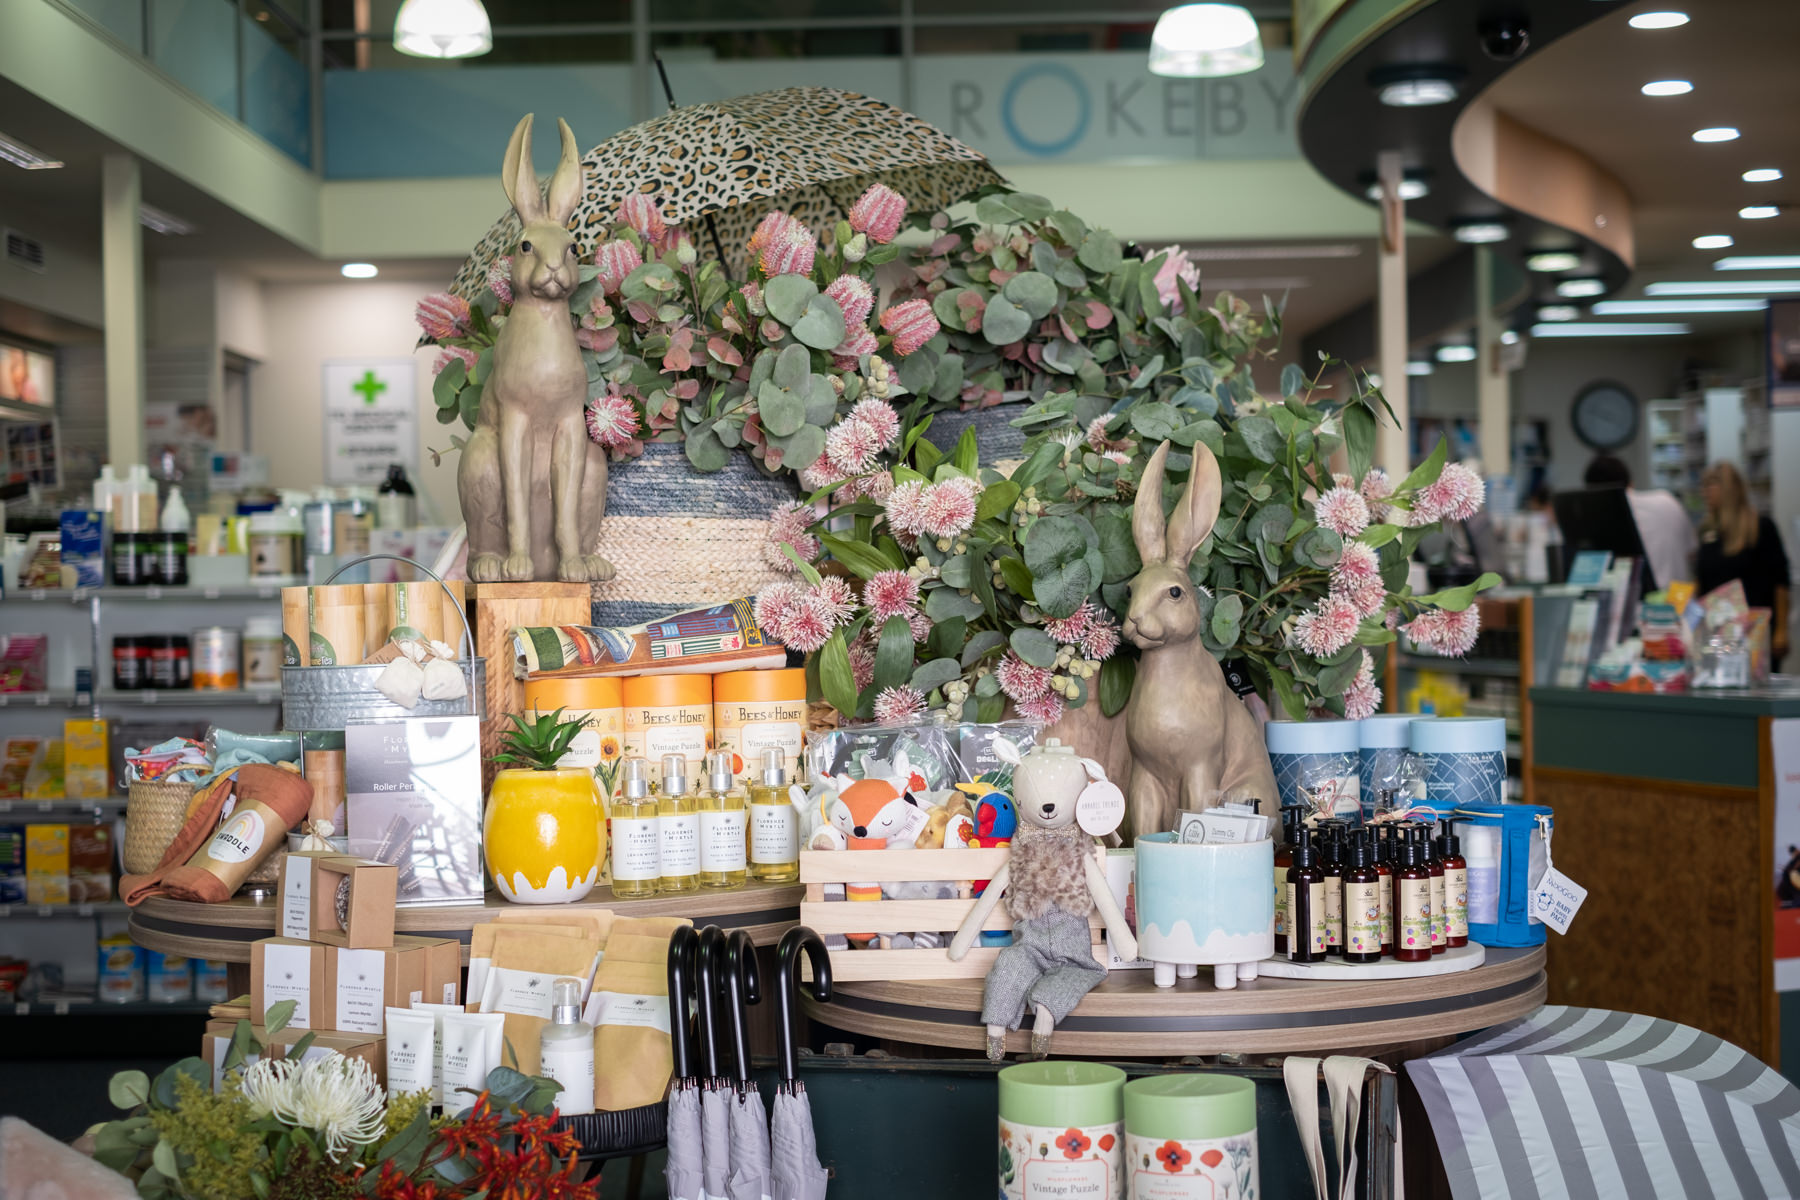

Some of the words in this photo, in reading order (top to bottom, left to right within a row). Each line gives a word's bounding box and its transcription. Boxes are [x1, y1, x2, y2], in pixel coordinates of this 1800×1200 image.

[951, 62, 1300, 158] ROKEBY
[642, 711, 671, 725] BEES
[679, 709, 706, 724] HONEY
[738, 707, 767, 721] BEES
[775, 706, 803, 720] HONEY
[652, 743, 680, 752] Vintage
[680, 742, 701, 750] Puzzle
[747, 739, 776, 748] Vintage
[776, 738, 797, 746] Puzzle
[373, 783, 398, 792] Roller
[216, 832, 250, 855] SWADDLE
[1556, 900, 1572, 914] BABY
[1550, 911, 1566, 926] PACK
[390, 1050, 417, 1059] FLORENCE
[445, 1053, 469, 1062] FLORENCE
[1032, 1183, 1068, 1196] Vintage
[1070, 1183, 1100, 1194] Puzzle
